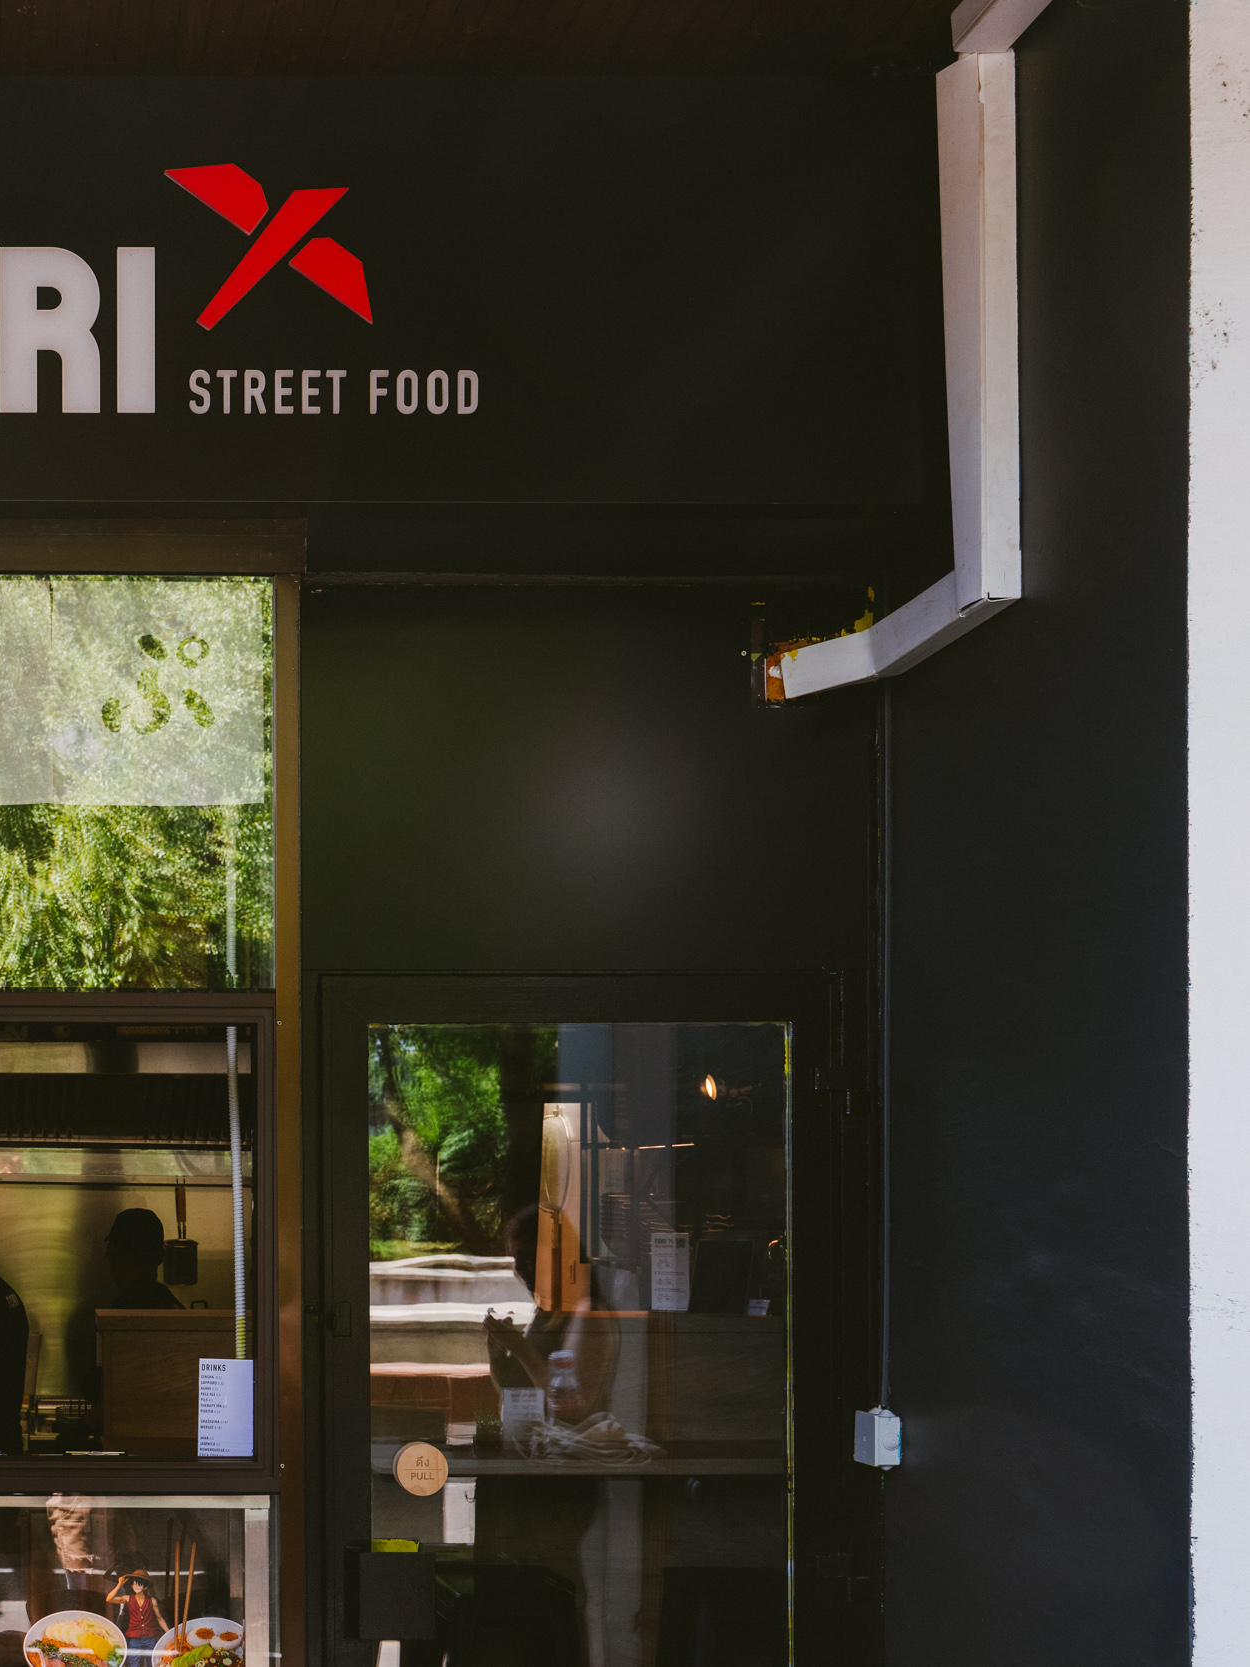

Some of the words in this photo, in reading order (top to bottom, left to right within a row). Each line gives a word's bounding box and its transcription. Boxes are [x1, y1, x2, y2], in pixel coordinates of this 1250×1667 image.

[189, 369, 348, 415] STREET
[369, 369, 480, 415] FOOD
[416, 1456, 430, 1467] ดึง
[411, 1472, 434, 1480] PULL
